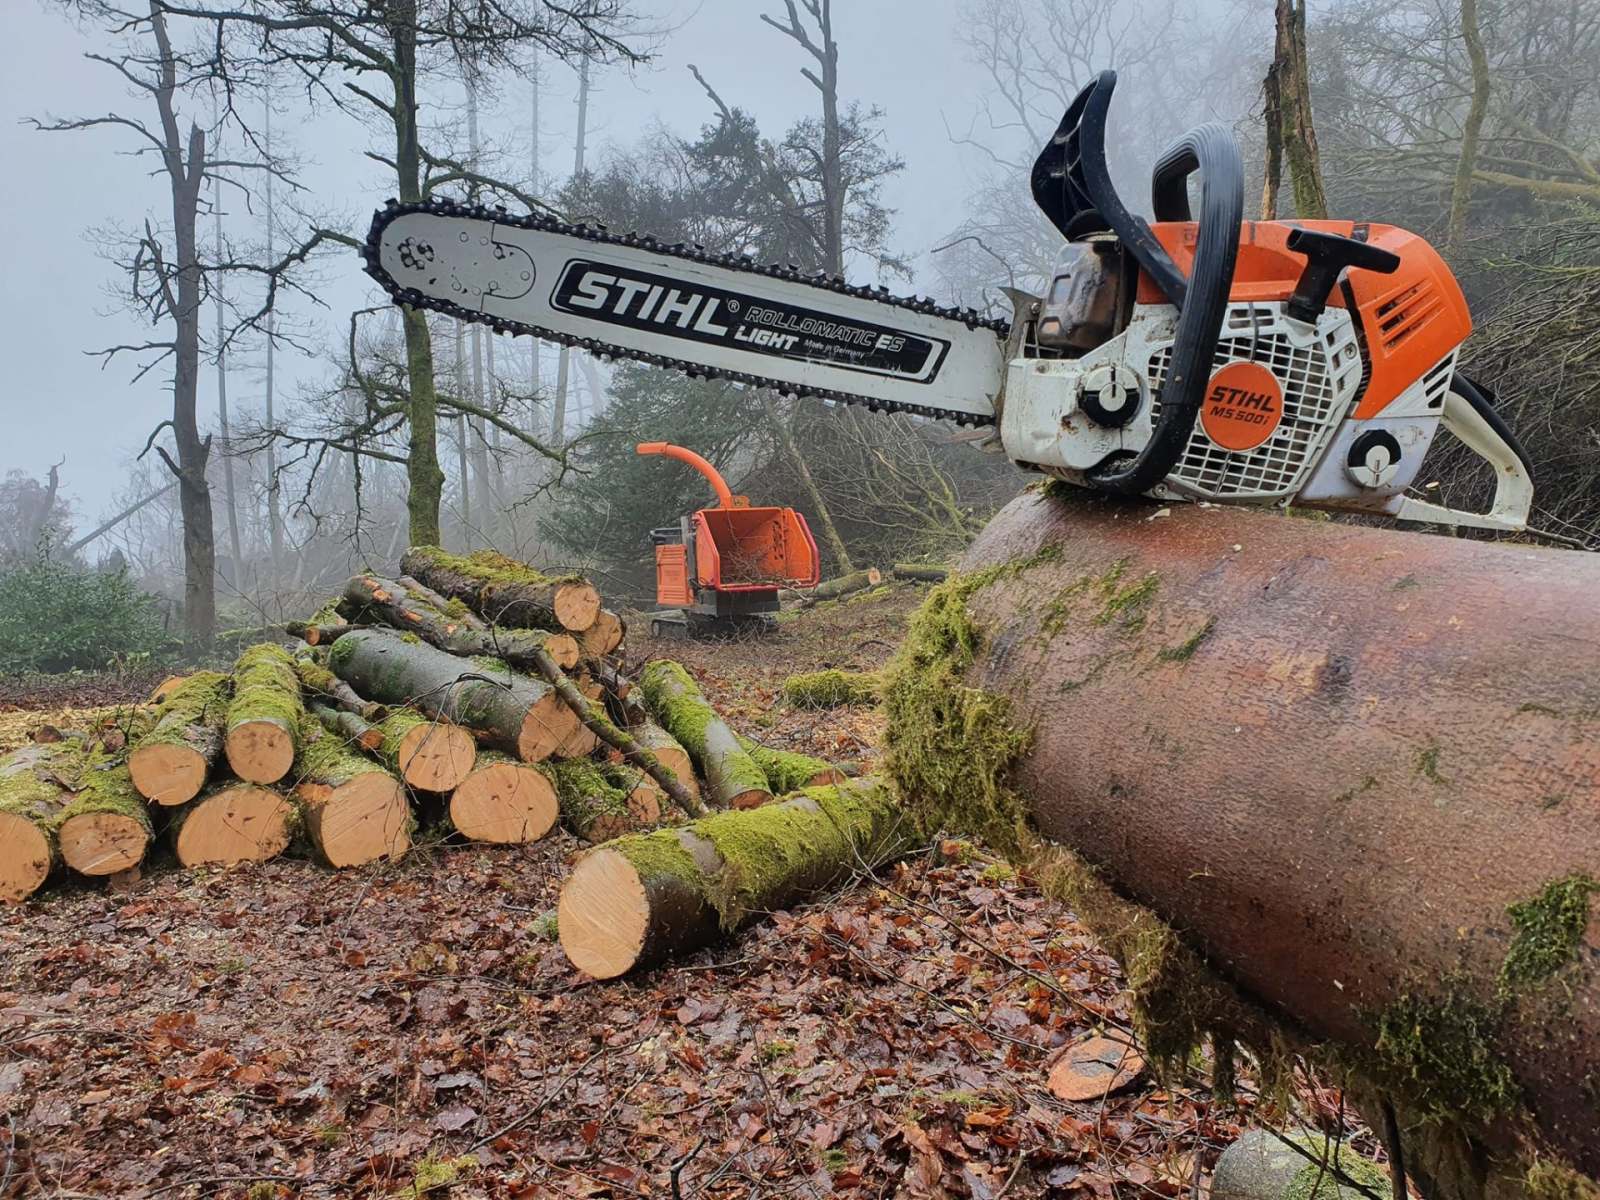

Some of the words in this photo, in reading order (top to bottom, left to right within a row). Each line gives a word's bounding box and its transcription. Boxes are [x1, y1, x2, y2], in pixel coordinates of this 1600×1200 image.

[734, 325, 799, 350] LIGHT
[745, 306, 876, 346] ROLLOMATIC
[875, 333, 906, 352] ES
[804, 339, 824, 350] Made
[833, 345, 865, 358] Germany
[1209, 386, 1275, 412] STIHL
[1210, 406, 1236, 419] MS
[1235, 410, 1270, 425] 500i
